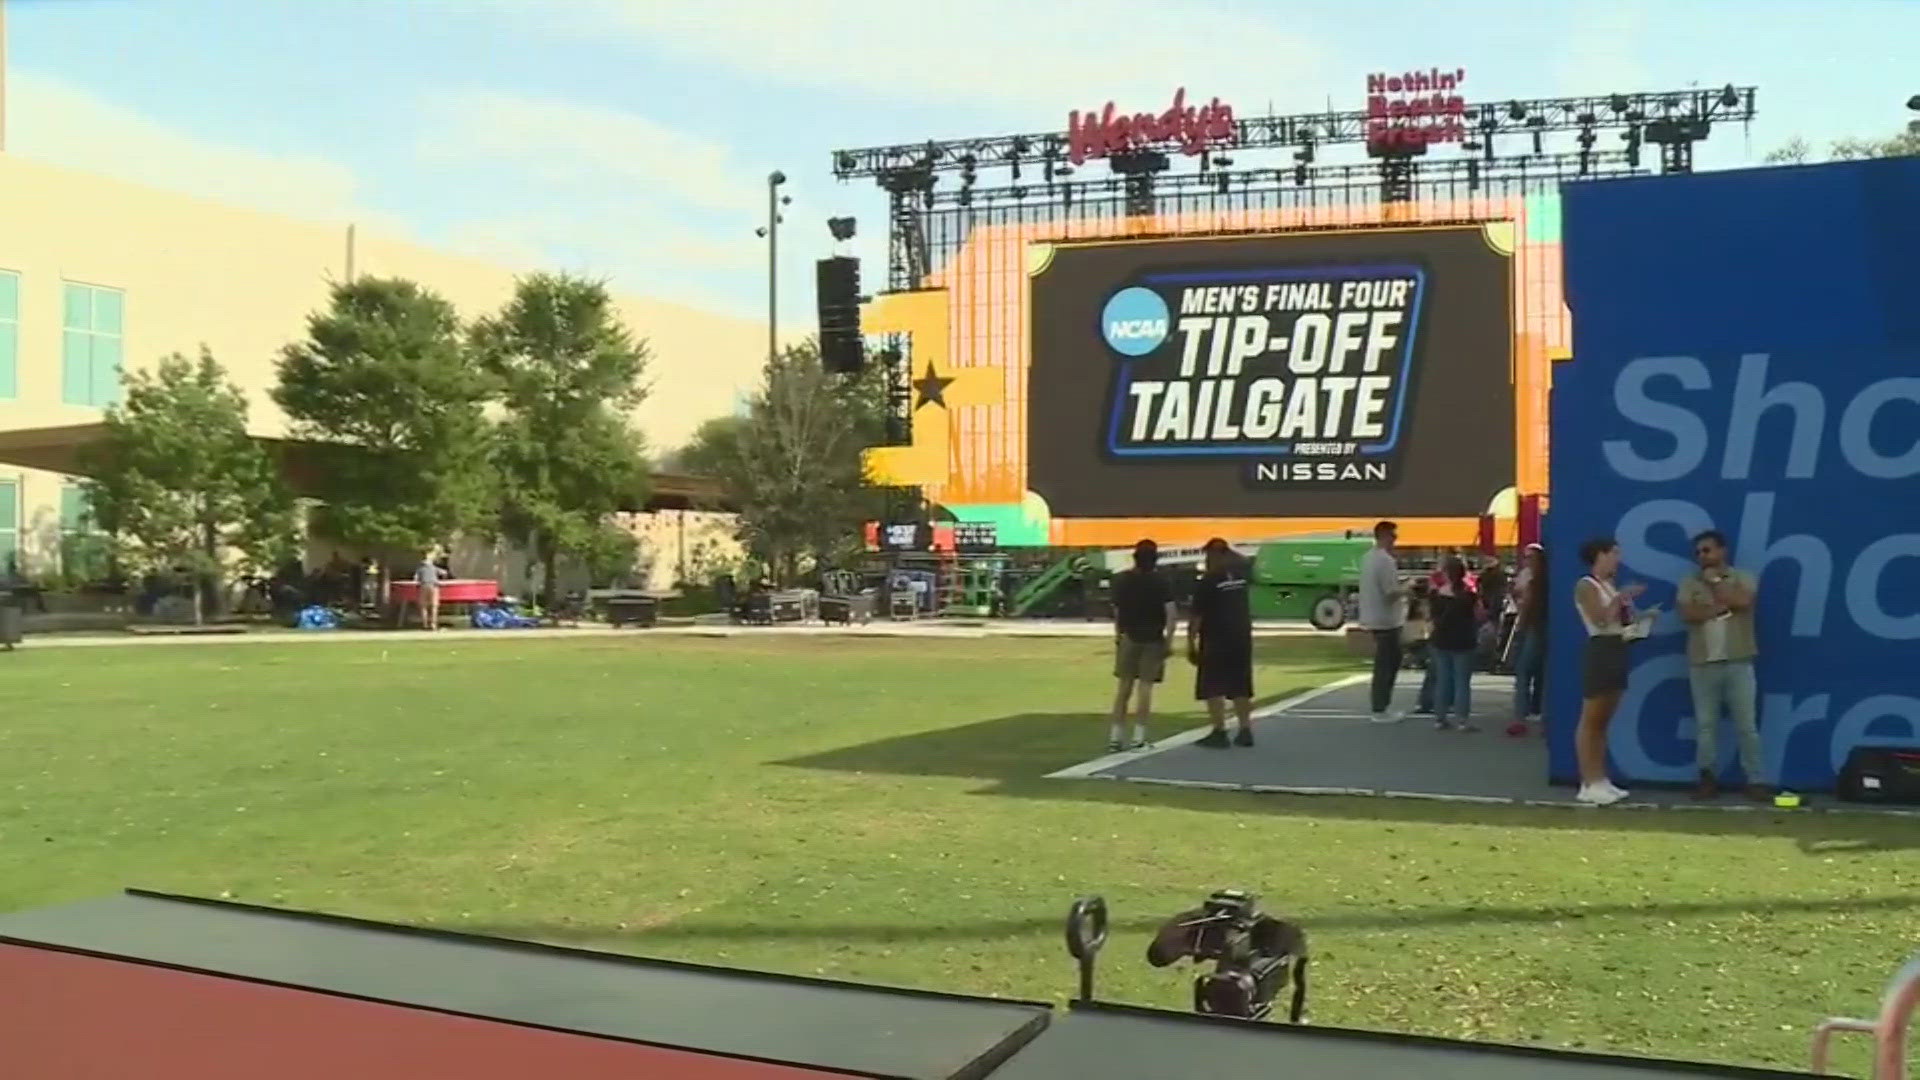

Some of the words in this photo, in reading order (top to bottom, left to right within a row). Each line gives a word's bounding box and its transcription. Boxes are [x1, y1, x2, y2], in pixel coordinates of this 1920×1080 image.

[1367, 68, 1464, 93] Nothin'
[1069, 86, 1235, 165] Wendy's
[1181, 285, 1260, 314] MEN'S
[1265, 281, 1333, 311] FINAL
[1110, 319, 1167, 339] NCAA
[1178, 311, 1403, 377] TIP-OFF
[1129, 376, 1391, 442] TAILGATE
[1293, 442, 1342, 455] PRESENTED
[1343, 442, 1358, 455] BY
[1257, 463, 1387, 481] NISSAN
